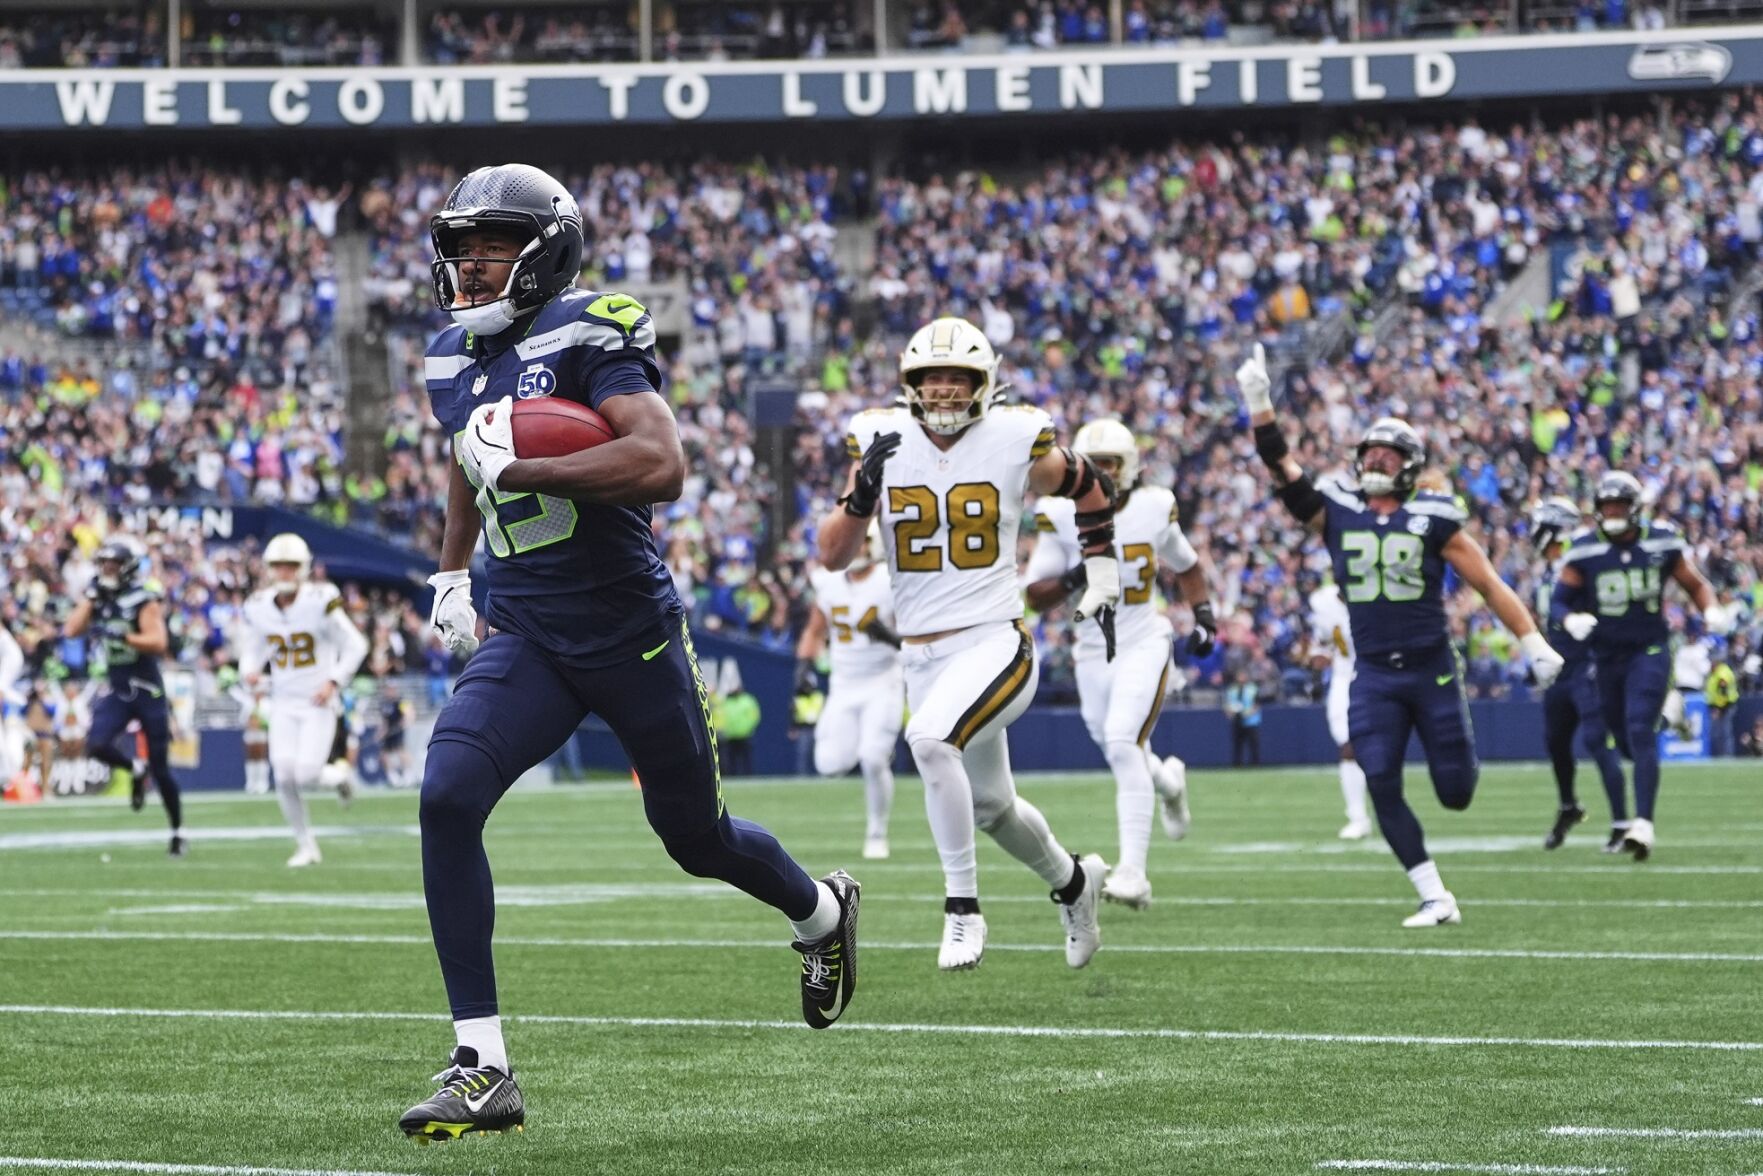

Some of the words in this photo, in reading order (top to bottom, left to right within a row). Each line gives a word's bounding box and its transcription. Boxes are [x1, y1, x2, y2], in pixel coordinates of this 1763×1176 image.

[55, 75, 530, 126] WELCOME
[597, 70, 710, 120] TO
[782, 62, 1104, 118] LUMEN
[1176, 50, 1457, 106] FIELD
[519, 369, 557, 399] 50
[887, 481, 1000, 573] 28
[1122, 543, 1154, 605] 3
[1342, 531, 1425, 603] 38
